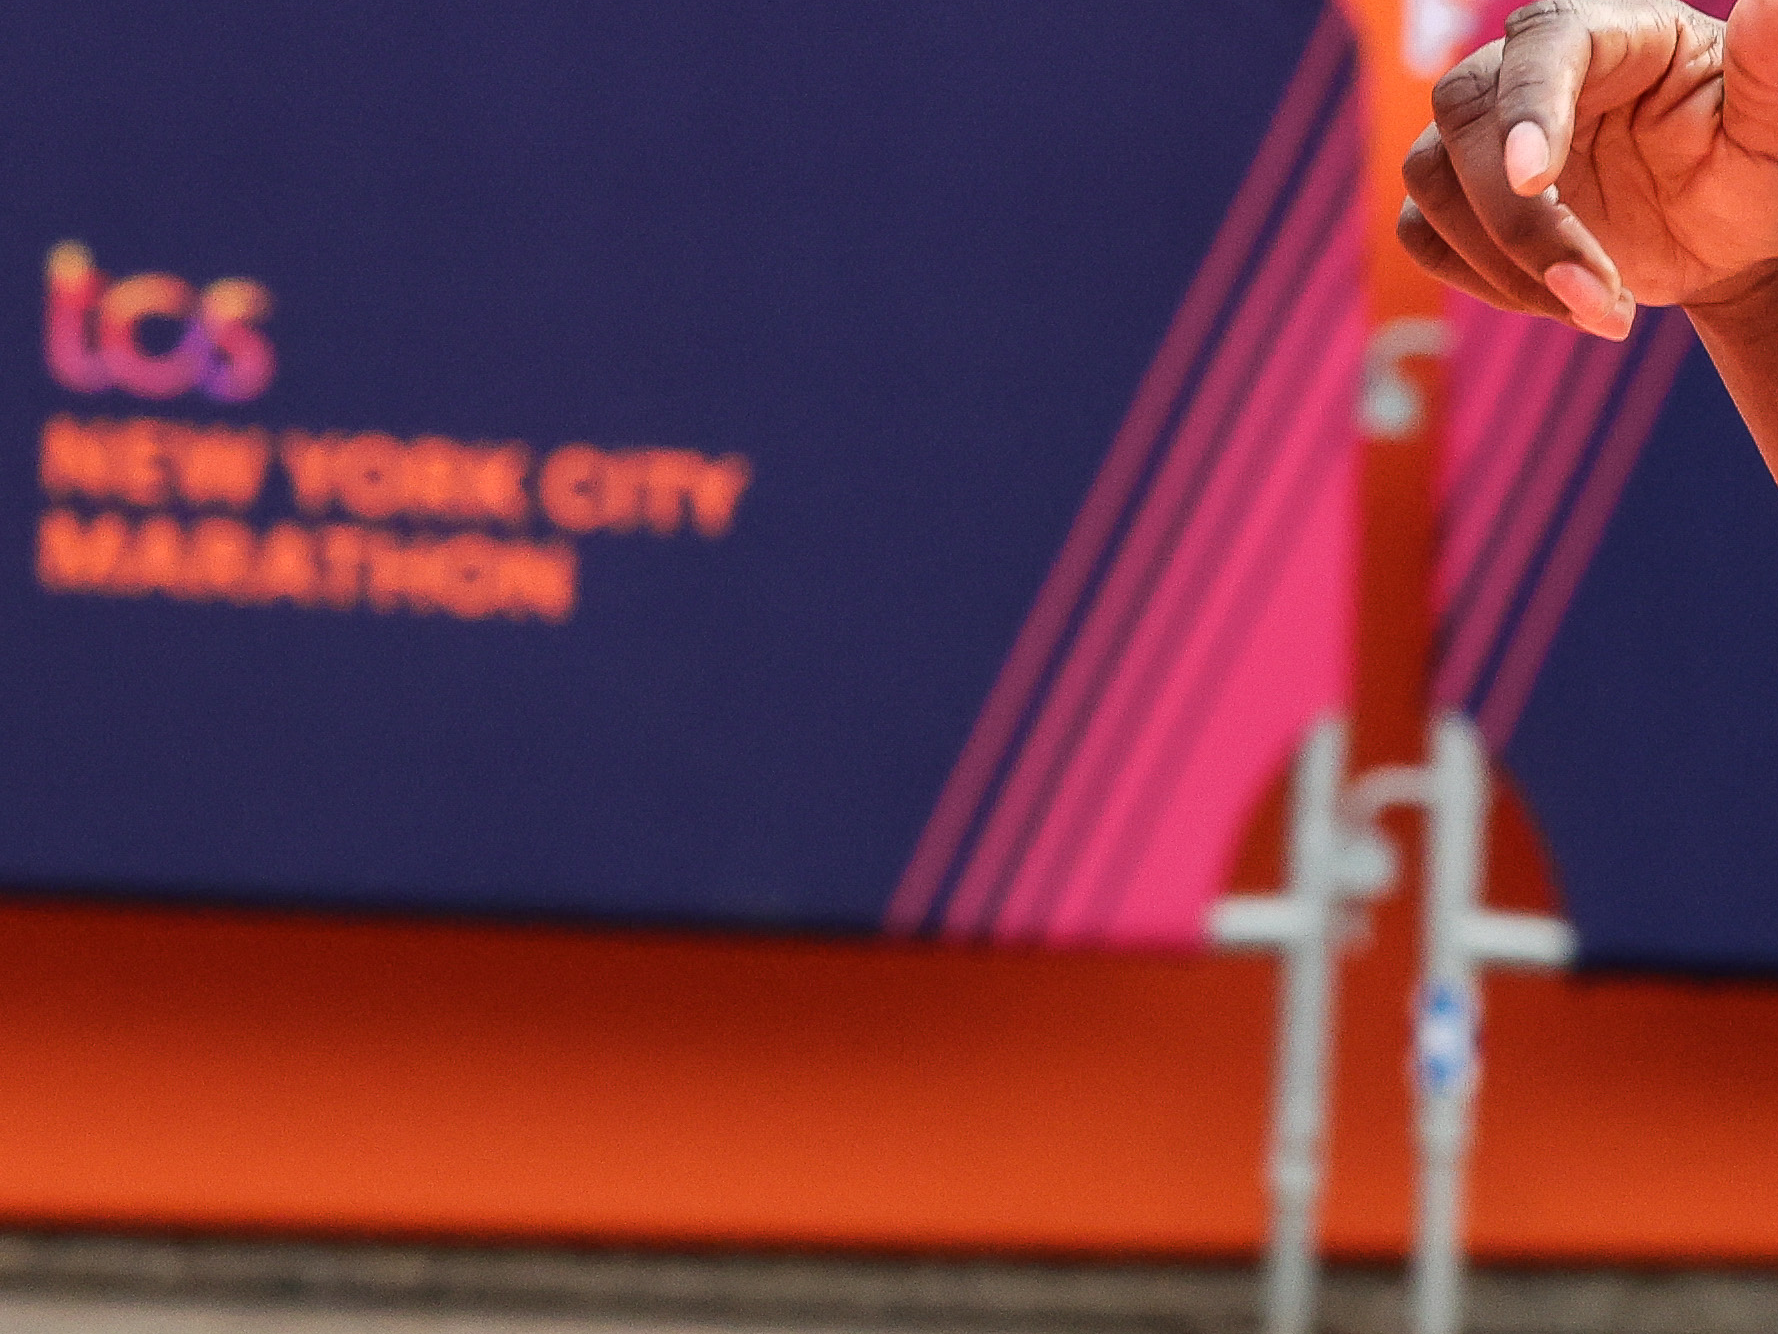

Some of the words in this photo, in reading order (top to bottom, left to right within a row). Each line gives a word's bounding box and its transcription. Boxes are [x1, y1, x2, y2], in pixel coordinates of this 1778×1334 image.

[43, 239, 277, 403] tcs
[40, 414, 269, 507] NEW
[284, 430, 530, 525] YORK
[541, 443, 752, 539] CITY
[37, 509, 578, 624] MARATHON
